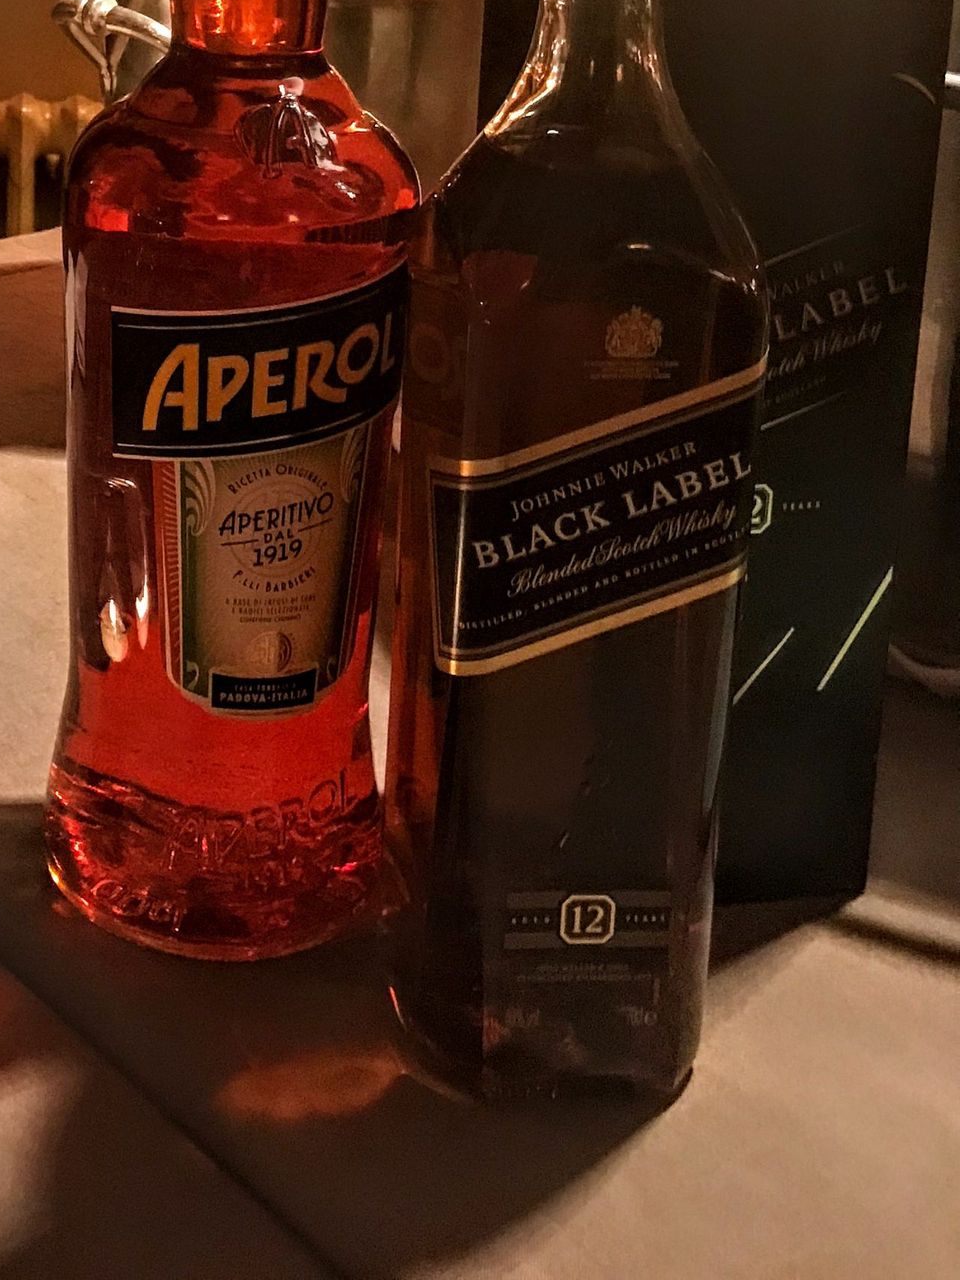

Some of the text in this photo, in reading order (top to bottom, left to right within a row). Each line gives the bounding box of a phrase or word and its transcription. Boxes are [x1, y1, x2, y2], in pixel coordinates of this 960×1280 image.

[773, 266, 909, 342] LABEL
[141, 311, 397, 432] APEROL
[218, 491, 334, 537] APERITIVO
[472, 452, 752, 568] BLACK LABEL
[509, 440, 698, 521] JOHNNIE WALKER
[252, 539, 303, 568] 1919
[263, 528, 295, 544] DAL
[506, 553, 600, 598] Blended
[657, 499, 737, 544] Whisky
[571, 905, 604, 934] 12
